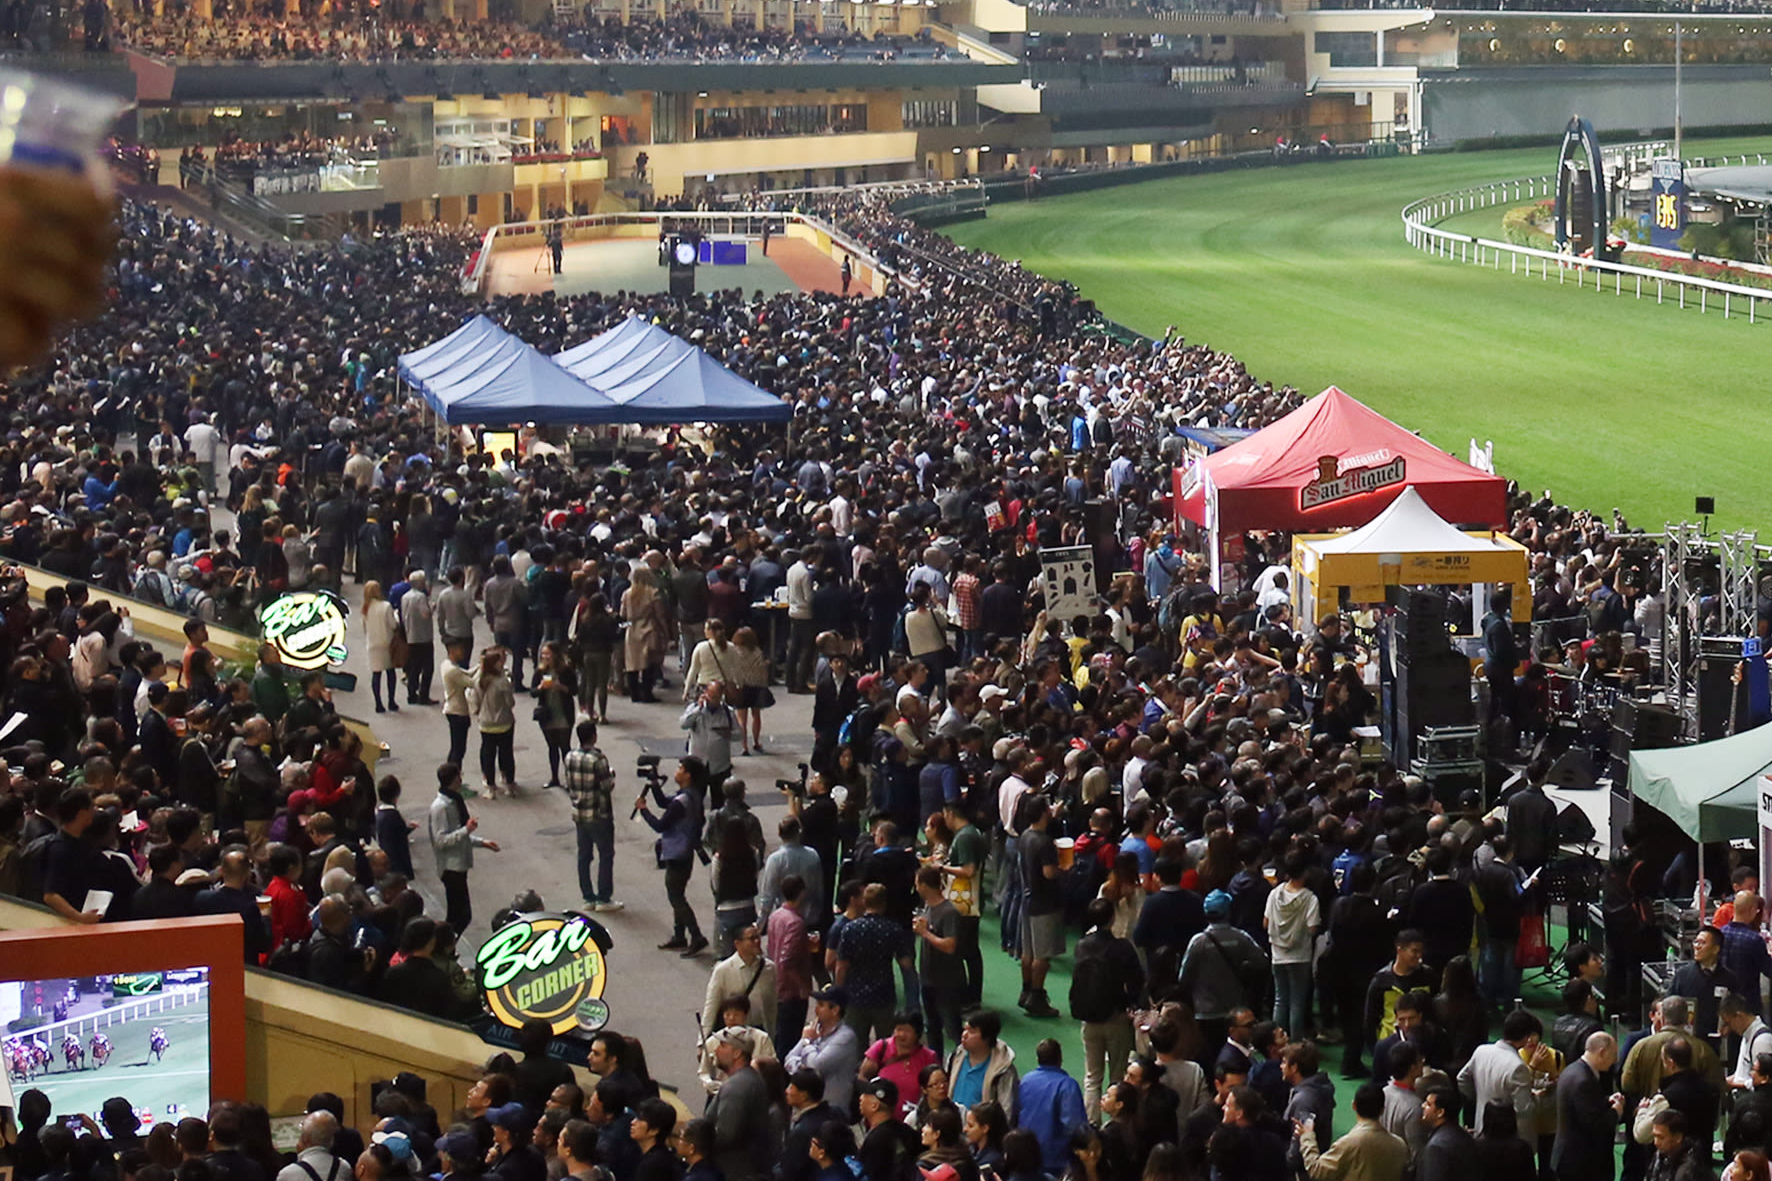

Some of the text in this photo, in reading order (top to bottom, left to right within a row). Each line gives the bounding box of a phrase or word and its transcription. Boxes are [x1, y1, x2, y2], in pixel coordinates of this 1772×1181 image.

[1306, 461, 1401, 503] San Miguel
[261, 594, 332, 639] Bar
[477, 917, 590, 988] Bar
[516, 952, 599, 1011] CORNER
